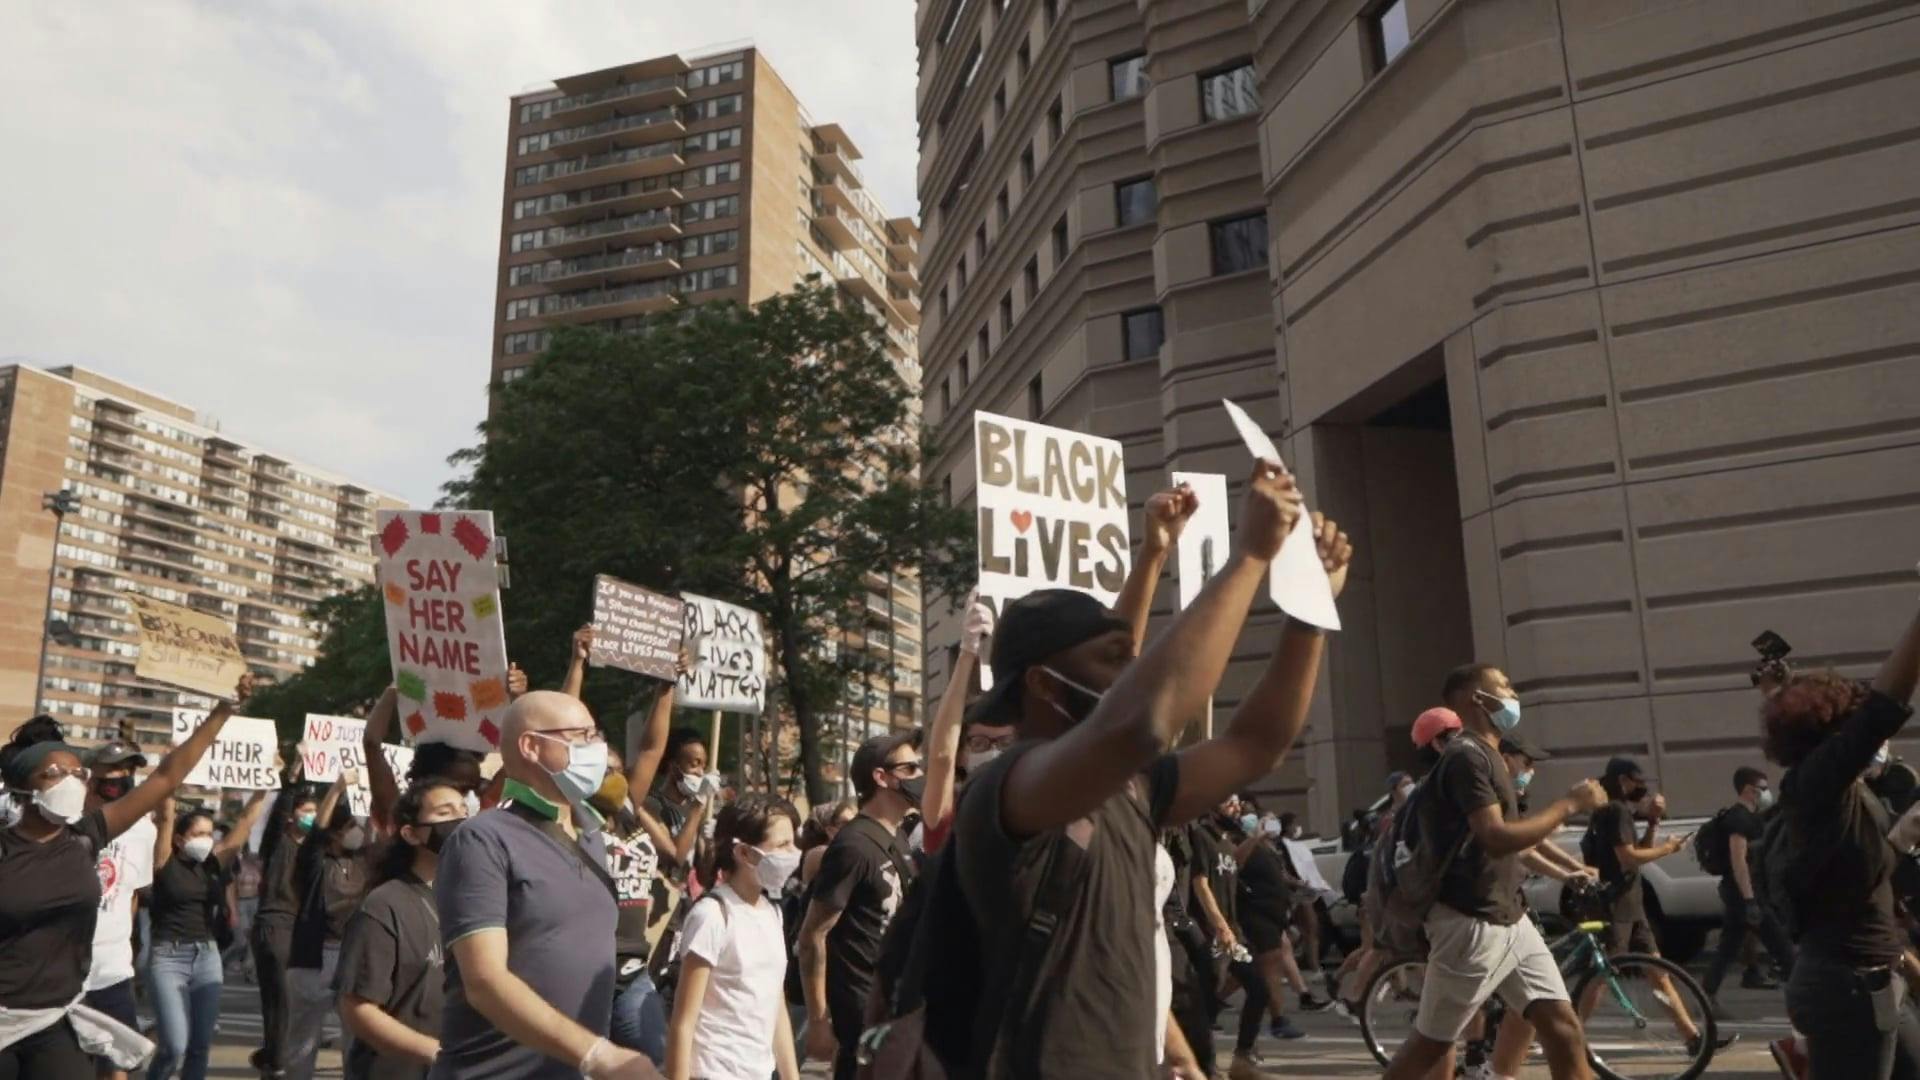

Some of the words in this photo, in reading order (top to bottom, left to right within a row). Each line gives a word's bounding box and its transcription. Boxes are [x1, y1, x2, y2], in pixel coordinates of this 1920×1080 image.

[978, 420, 1128, 509] BLACK
[406, 558, 462, 593] SAY
[409, 597, 467, 635] HER
[683, 602, 755, 642] BLACK
[398, 631, 481, 676] NAME
[682, 669, 762, 711] MATTER
[308, 720, 333, 741] NO
[209, 740, 263, 764] THEIR
[303, 751, 326, 776] NO
[208, 764, 276, 788] NAMES
